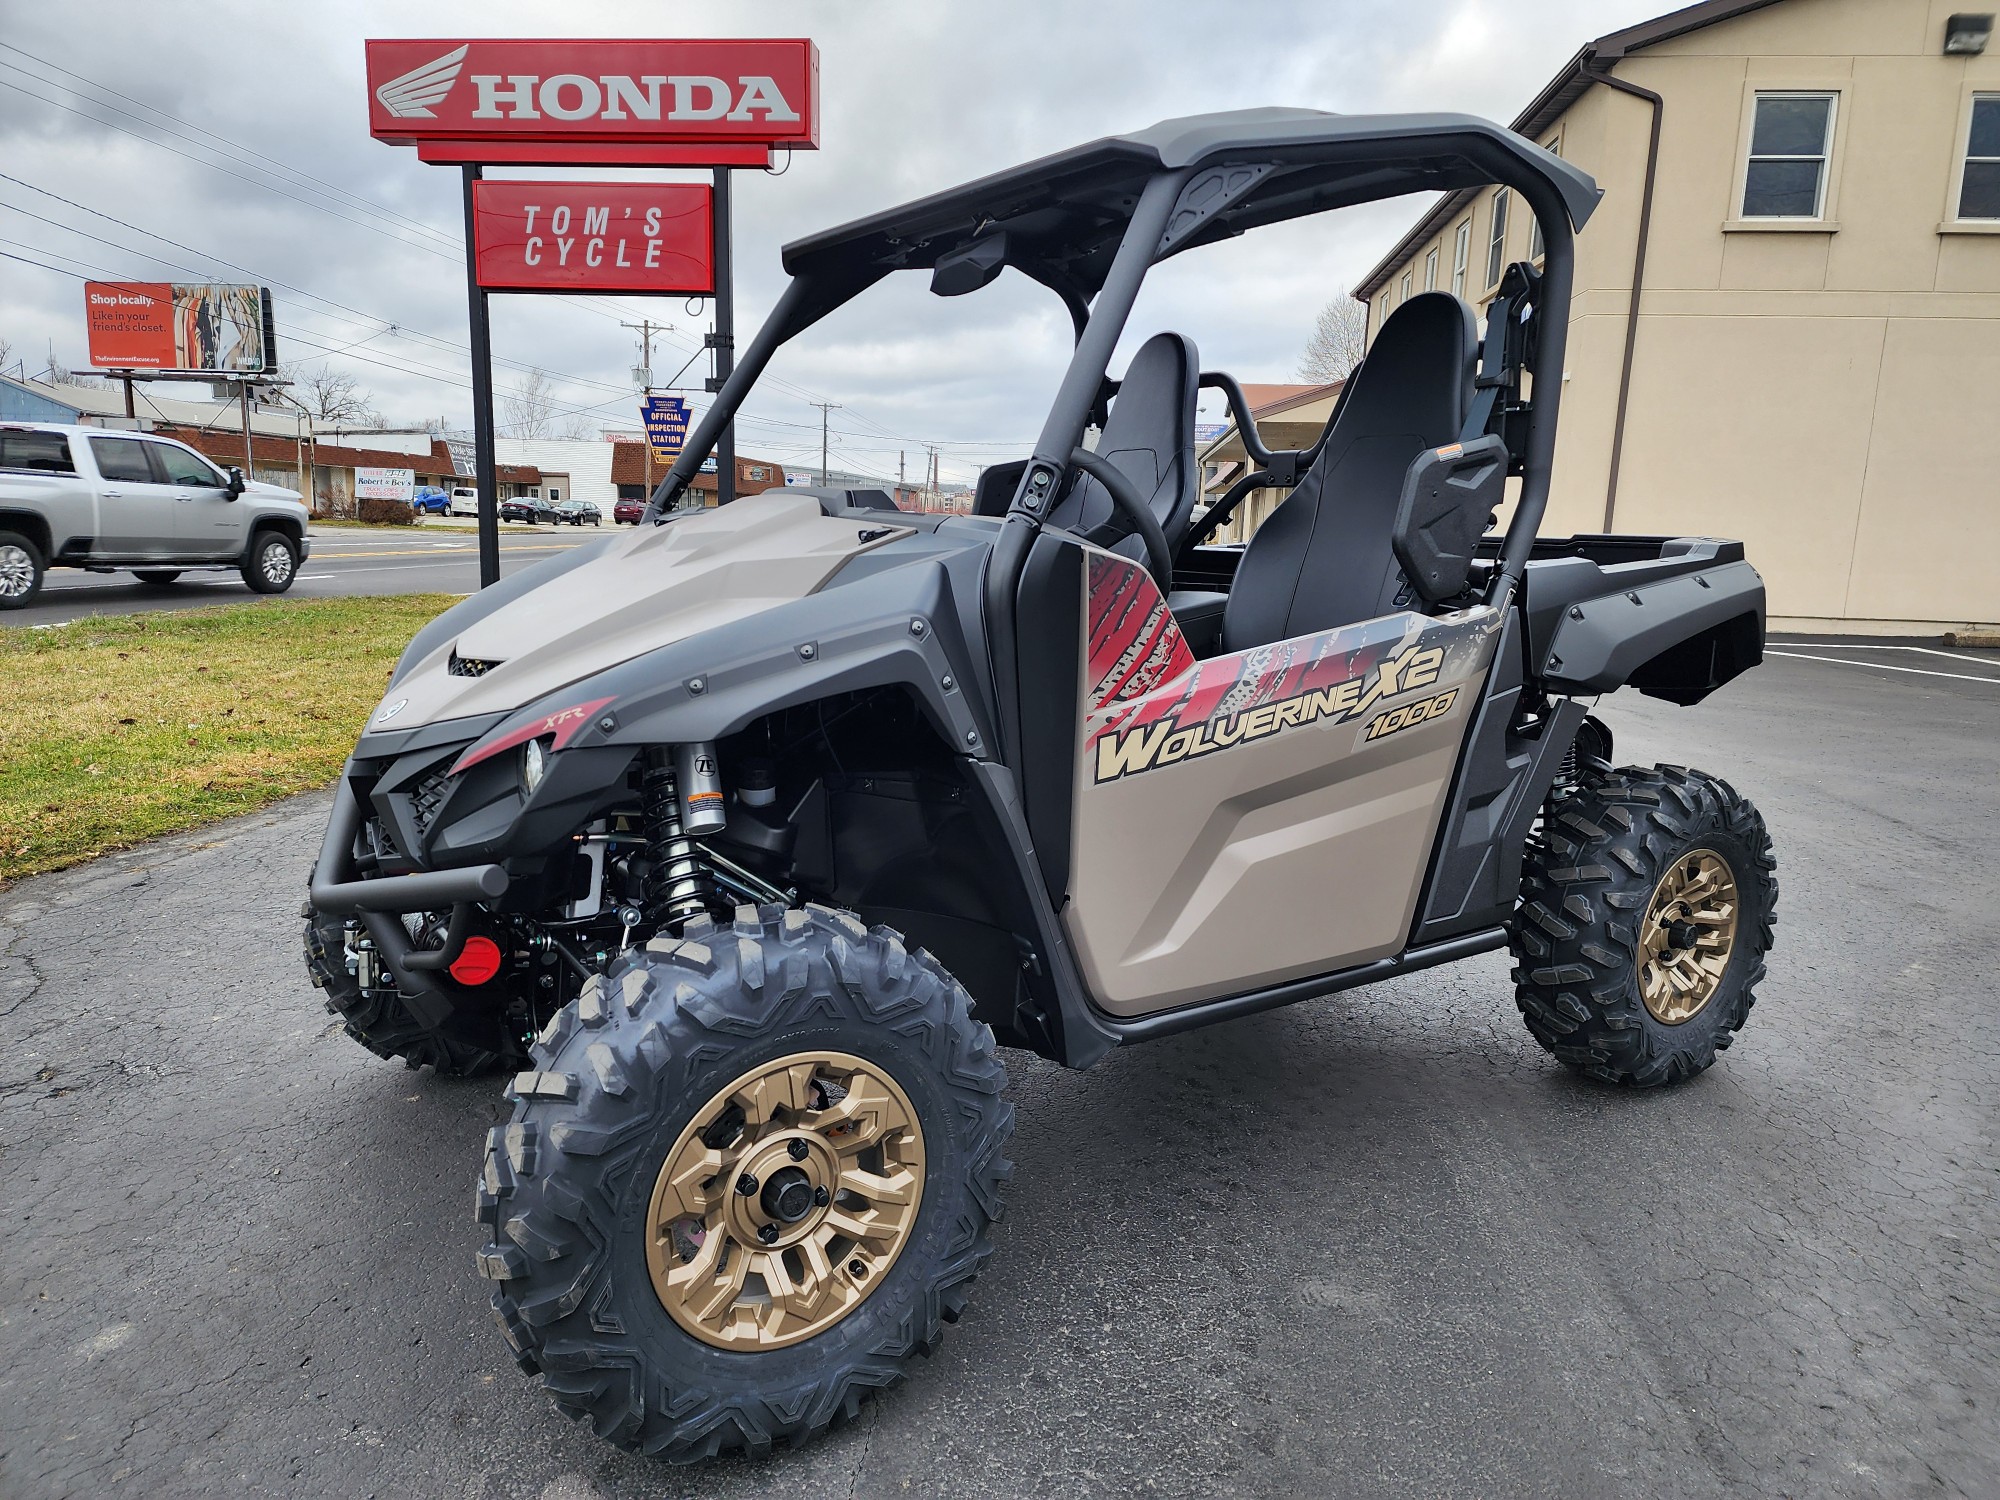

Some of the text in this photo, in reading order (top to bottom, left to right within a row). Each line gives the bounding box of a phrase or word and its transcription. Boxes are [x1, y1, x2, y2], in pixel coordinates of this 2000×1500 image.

[471, 74, 801, 122] HONDA
[523, 205, 663, 237] TOM'S
[523, 236, 664, 268] CYCLE
[90, 294, 155, 308] Shop locally.
[92, 310, 150, 322] Like in your
[92, 322, 167, 333] friend's closet.
[94, 355, 160, 363] TheEnvironmentExcuse.org
[651, 412, 682, 421] OFFICIAL
[647, 423, 686, 433] INSPECTION
[652, 434, 681, 444] STATION
[358, 477, 383, 485] Robert
[391, 478, 412, 486] Bev's
[1096, 645, 1446, 783] WOLVERINE X2
[1364, 688, 1461, 743] 1000
[695, 758, 716, 774] ZF
